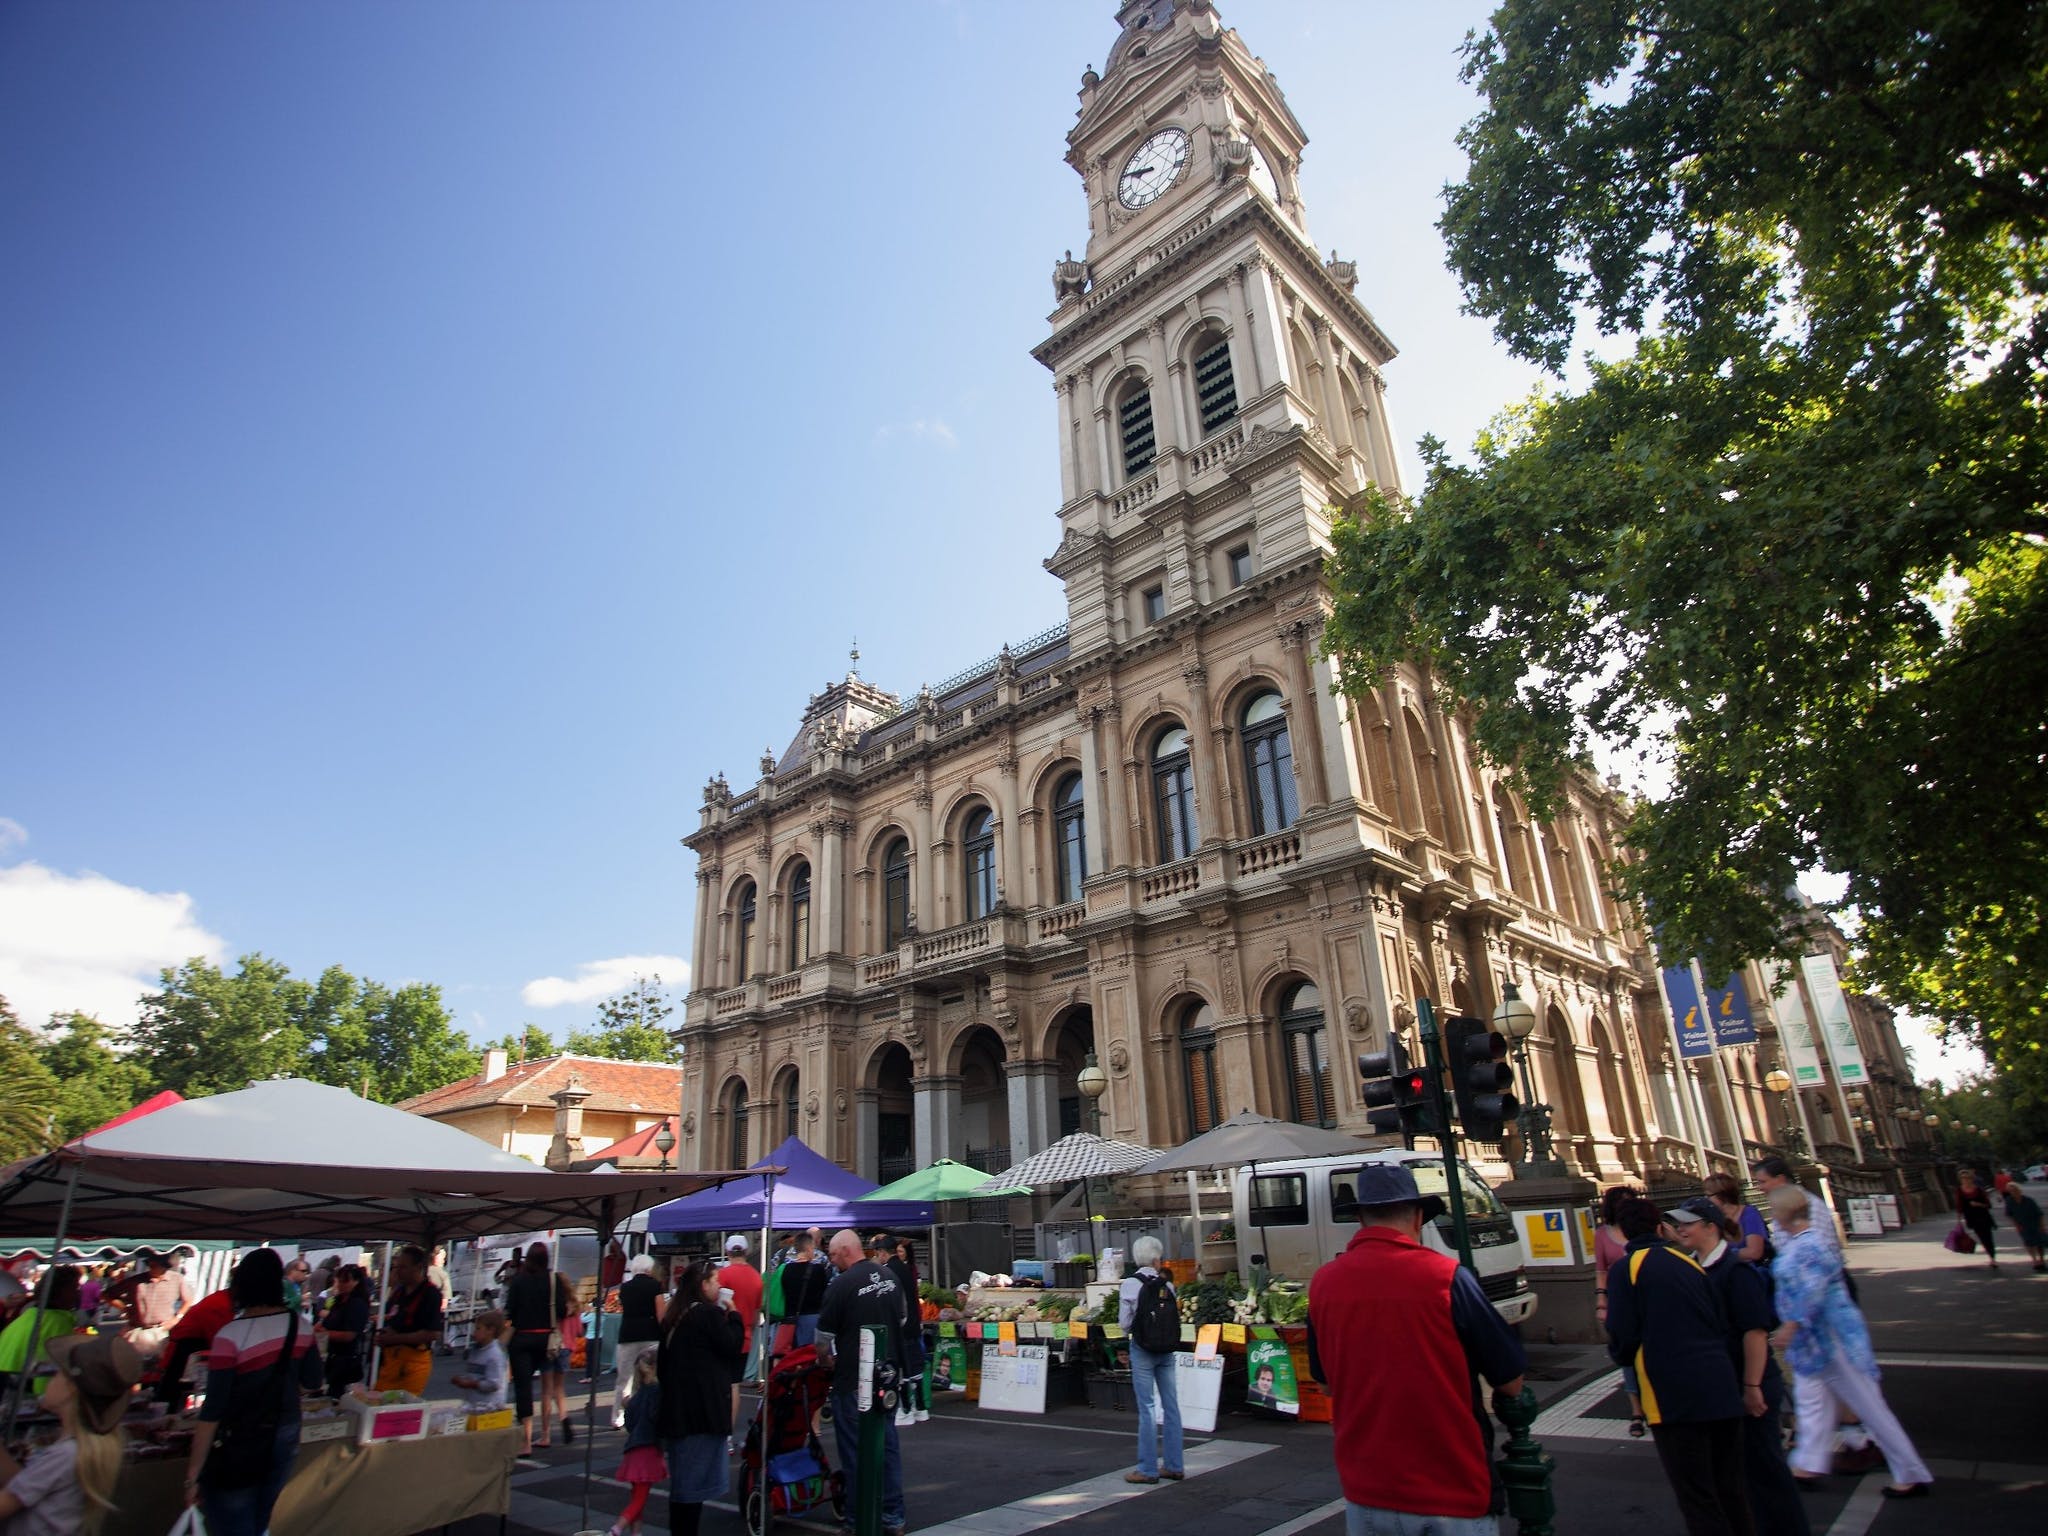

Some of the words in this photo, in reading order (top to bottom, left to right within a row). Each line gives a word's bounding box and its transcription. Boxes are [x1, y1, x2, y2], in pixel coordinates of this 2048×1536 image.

[1718, 1019, 1745, 1027] Visitor
[1719, 1027, 1749, 1036] Centre
[1250, 1345, 1287, 1362] Organic
